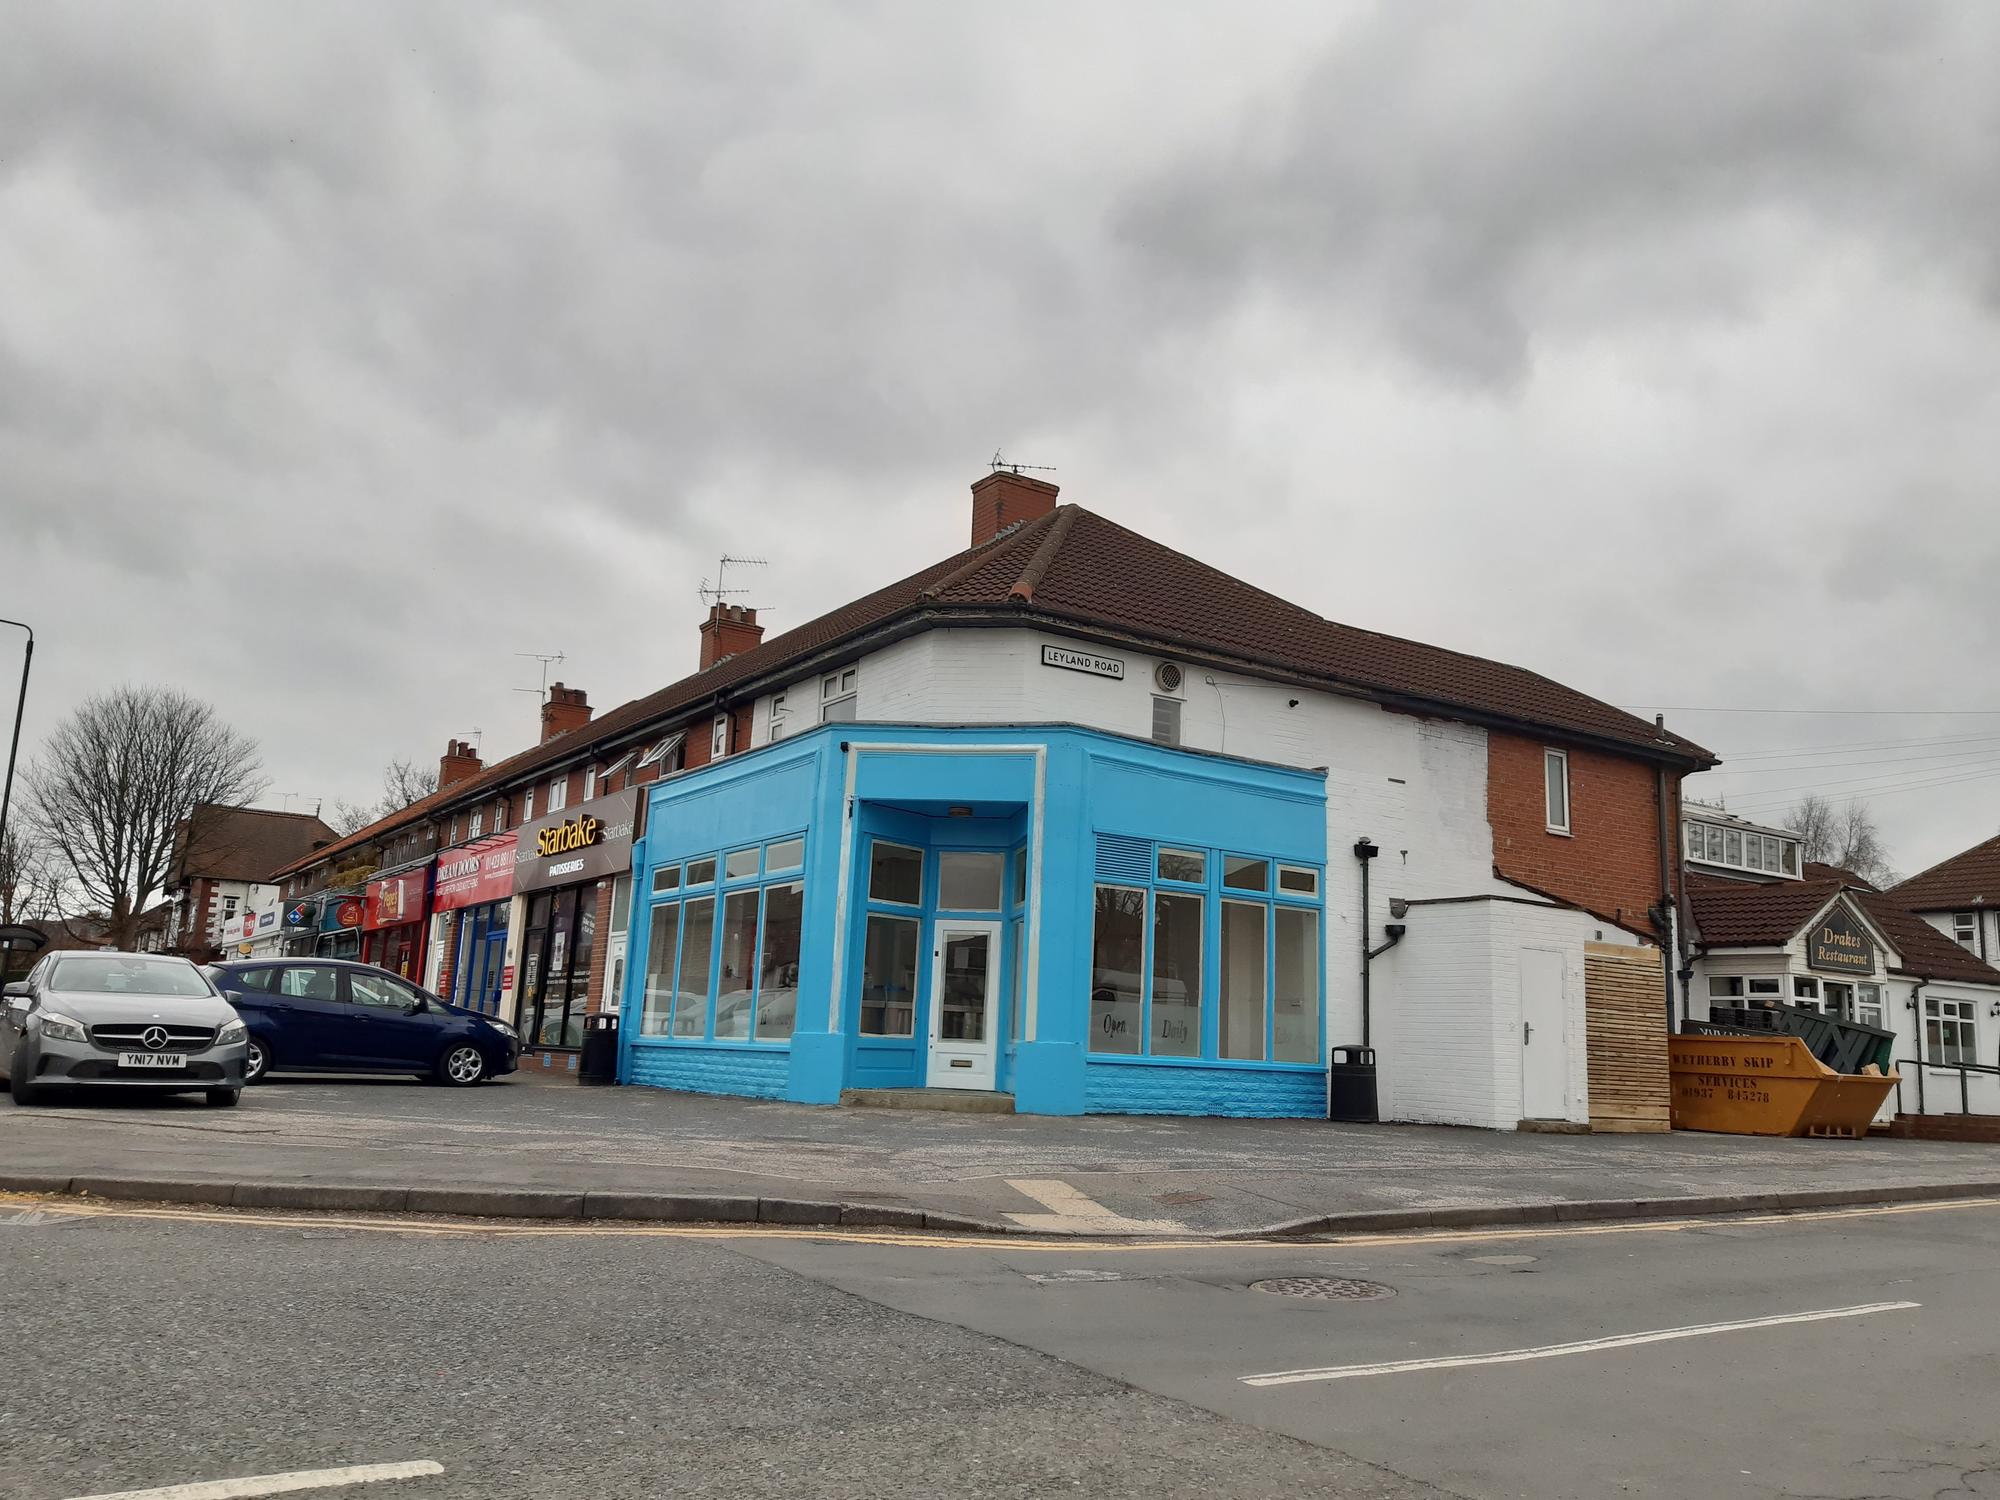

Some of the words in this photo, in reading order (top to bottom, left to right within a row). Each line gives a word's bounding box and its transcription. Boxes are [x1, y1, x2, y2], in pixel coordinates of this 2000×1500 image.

[1048, 651, 1091, 668] LEYLAND
[1094, 660, 1120, 673] ROAD
[537, 813, 597, 857] Starbake
[602, 819, 634, 842] Starbake
[549, 858, 585, 877] PATISSERIES
[1823, 927, 1861, 948] Drakes
[1818, 946, 1867, 965] Restaurant
[1103, 1014, 1126, 1038] Open
[1162, 1019, 1188, 1044] Daily
[127, 1054, 154, 1065] YN17
[1672, 1054, 1737, 1067] WETHERBY
[1743, 1056, 1774, 1068] SKIP
[1698, 1076, 1758, 1089] SERVICES
[1681, 1087, 1713, 1099] 01937
[1728, 1089, 1770, 1103] 845278
